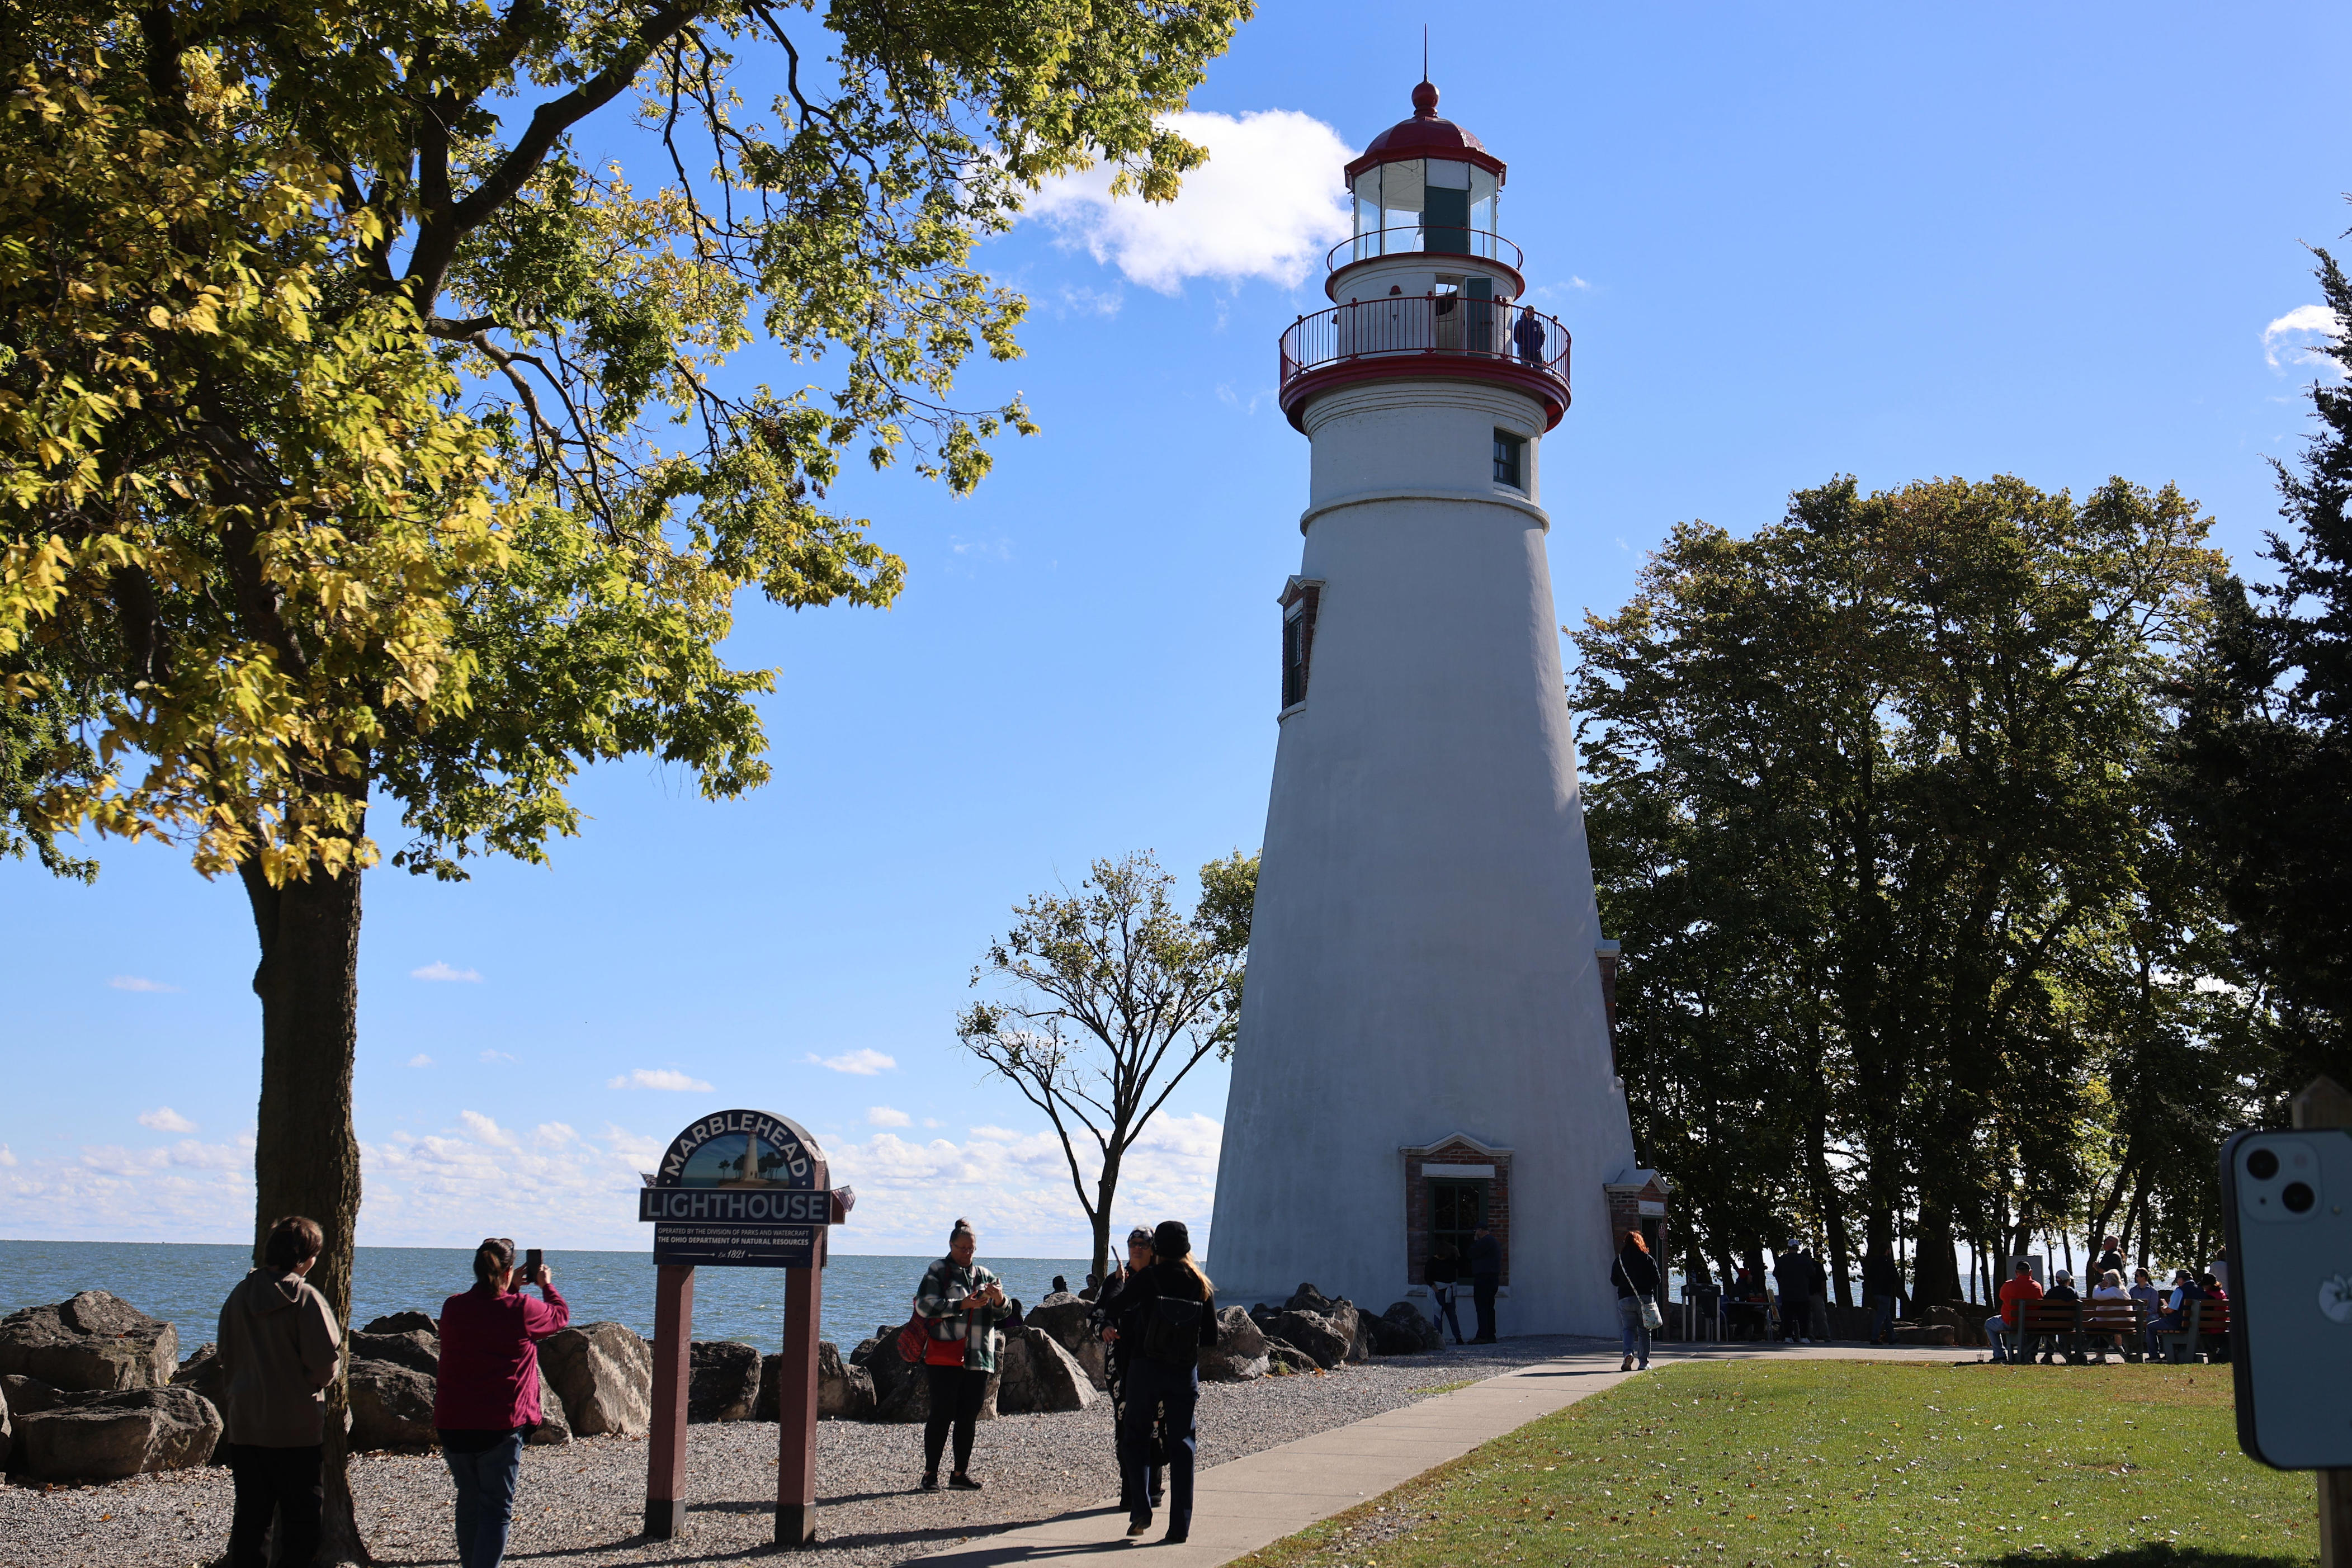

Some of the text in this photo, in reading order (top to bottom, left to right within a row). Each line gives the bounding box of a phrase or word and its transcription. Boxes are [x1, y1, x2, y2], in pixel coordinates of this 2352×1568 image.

[664, 1113, 807, 1178] MARBLEHEAD
[646, 1192, 824, 1220] LIGHTHOUSE
[727, 1249, 745, 1259] 1821
